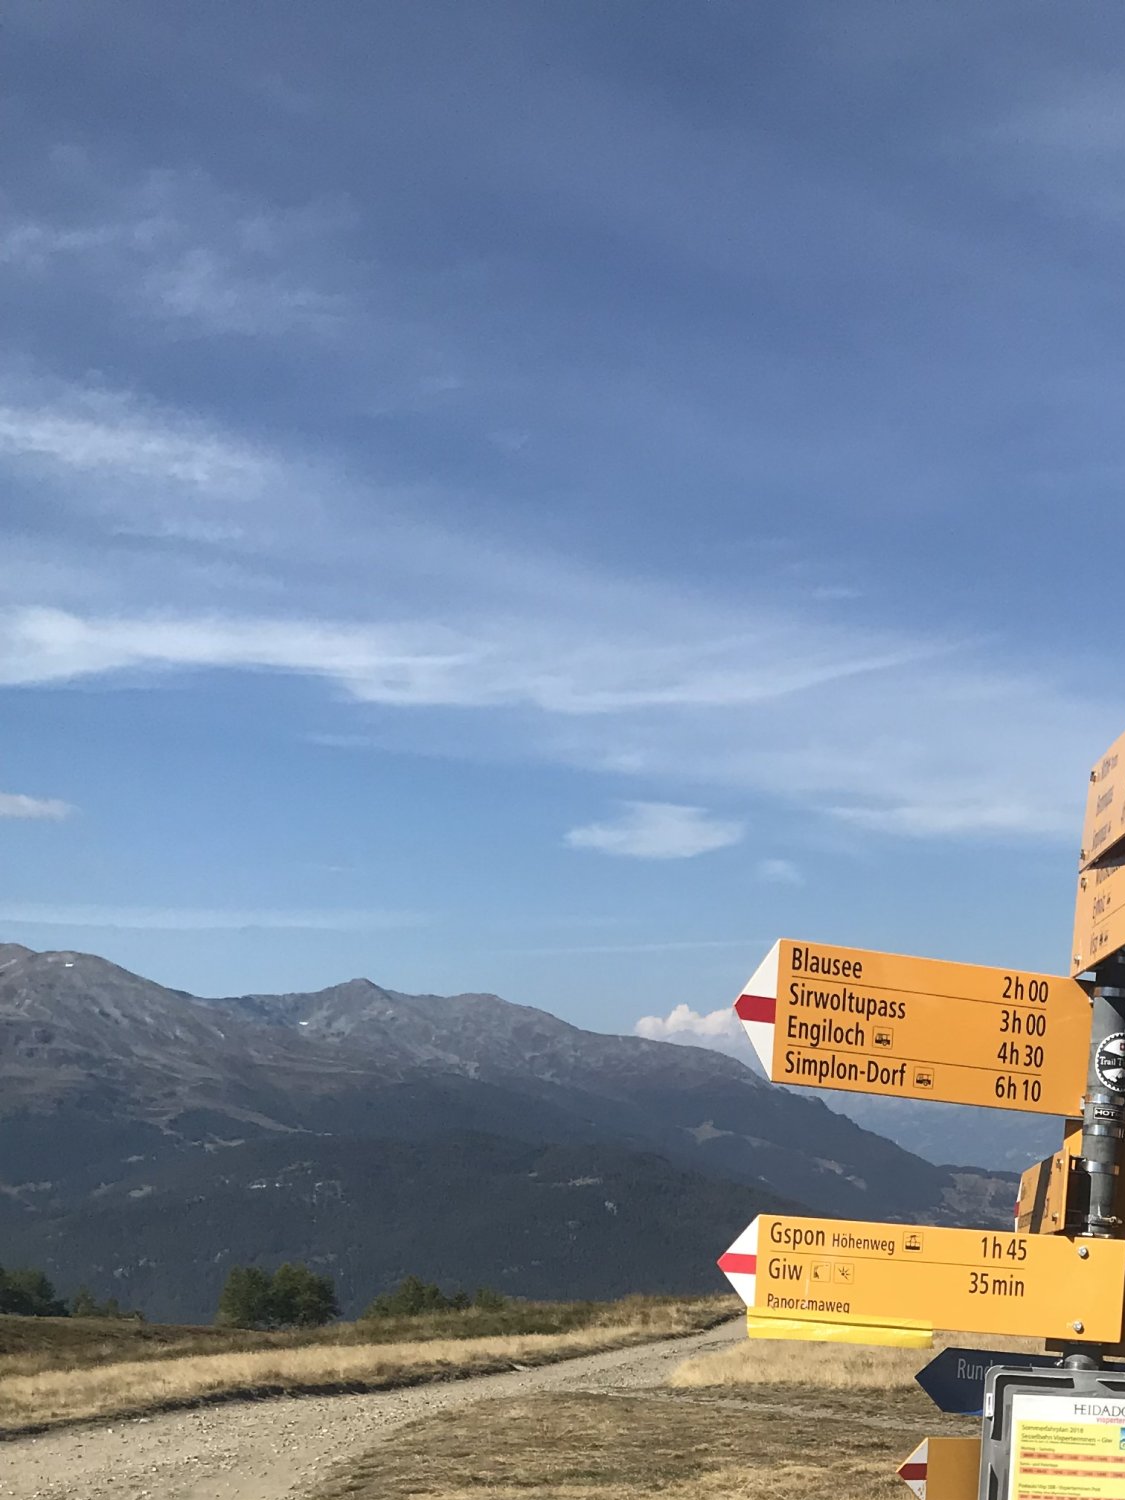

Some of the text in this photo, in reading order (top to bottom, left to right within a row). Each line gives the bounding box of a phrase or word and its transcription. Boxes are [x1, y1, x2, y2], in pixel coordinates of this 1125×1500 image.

[791, 947, 863, 981] Blausee
[788, 982, 906, 1021] Sirwoltupass
[787, 1015, 865, 1048] Engiloch
[784, 1050, 906, 1087] Simplon-Dorf
[1099, 1056, 1116, 1067] Trail
[770, 1221, 825, 1251] Gspon
[832, 1233, 895, 1256] Höhenweg
[768, 1257, 803, 1281] Giw
[767, 1293, 850, 1314] Panoramaweg
